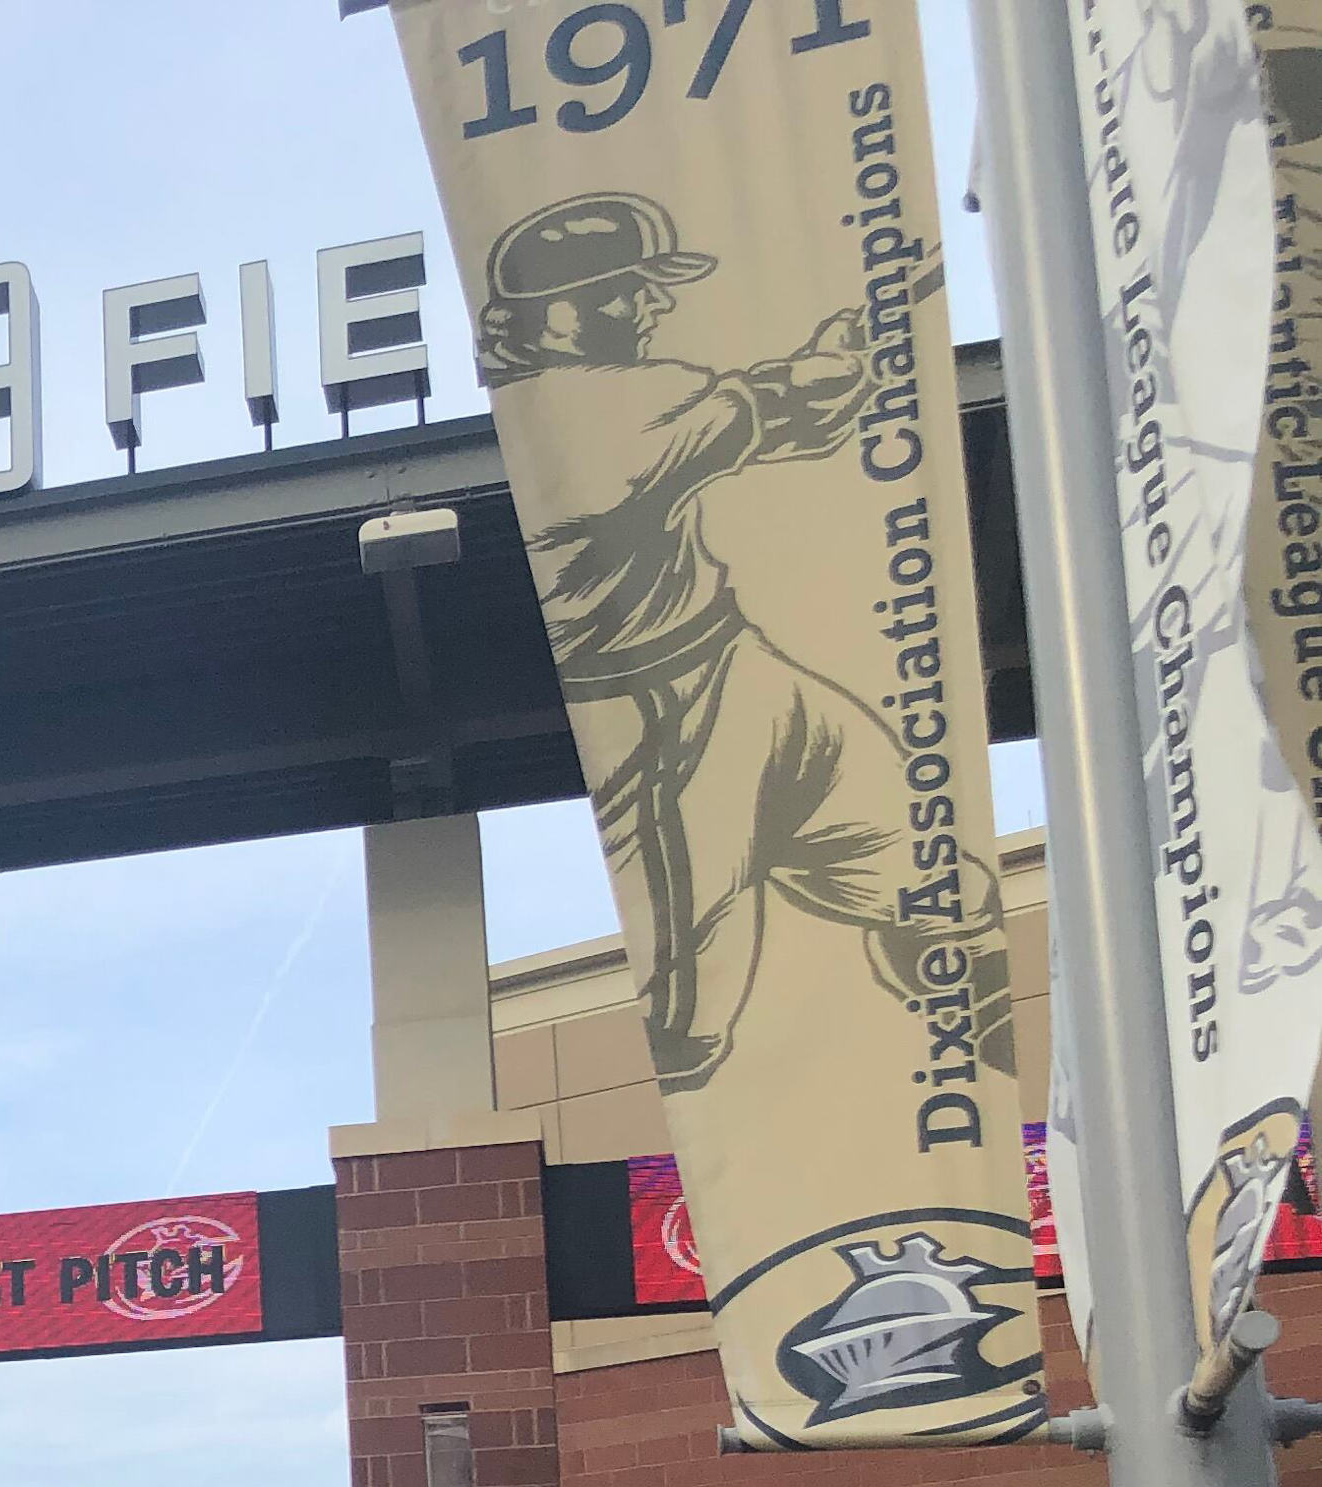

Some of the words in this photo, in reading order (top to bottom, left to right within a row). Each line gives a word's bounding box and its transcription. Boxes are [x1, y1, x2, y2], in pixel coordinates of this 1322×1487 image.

[101, 231, 429, 446] FIE
[839, 82, 923, 482] Champions
[873, 496, 963, 925] Association
[1120, 272, 1171, 568] League
[1157, 584, 1222, 1063] Champions
[907, 942, 985, 1154] Dixie
[59, 1245, 226, 1304] PITCH
